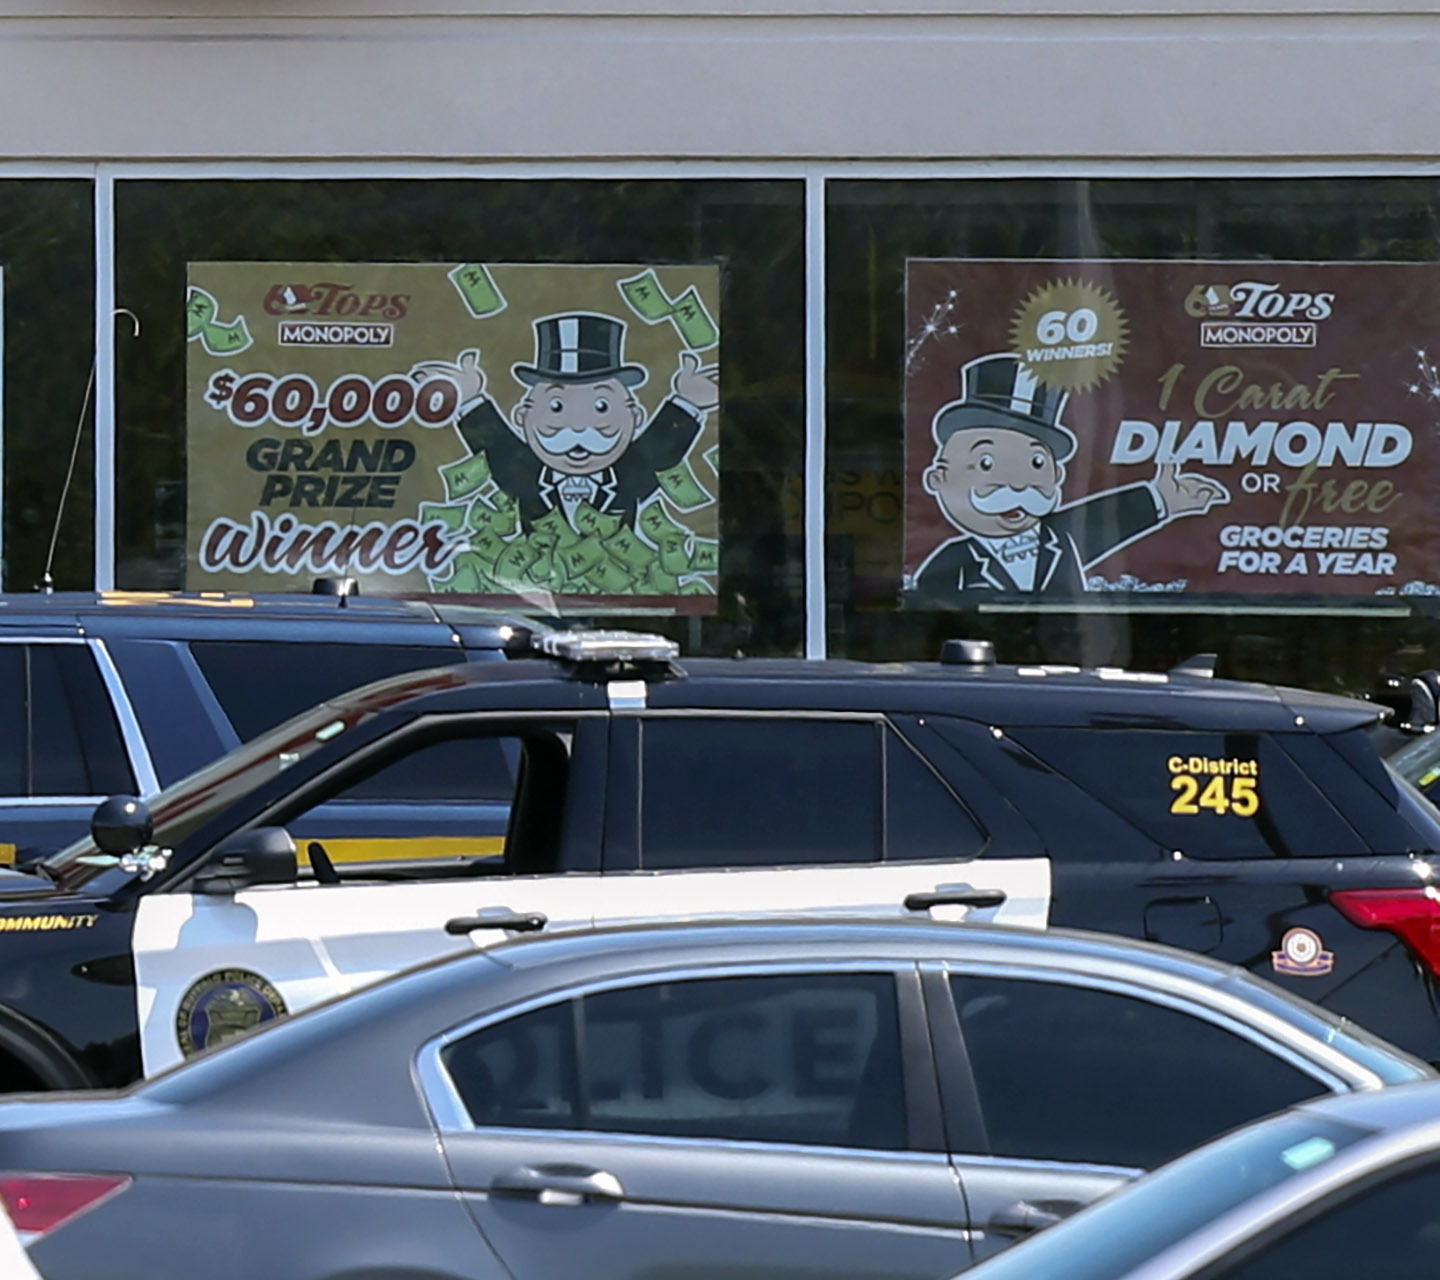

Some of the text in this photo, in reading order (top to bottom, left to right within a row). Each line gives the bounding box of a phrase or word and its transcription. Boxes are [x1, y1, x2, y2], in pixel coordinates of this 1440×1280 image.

[310, 282, 411, 320] TOPS
[1230, 281, 1335, 320] TOPS
[283, 325, 389, 343] MONOPOLY
[1036, 308, 1099, 345] 60
[1205, 326, 1312, 343] MONOPOLY
[1026, 343, 1113, 363] WINNERS!
[208, 374, 458, 430] $60,000
[1158, 364, 1360, 420] 1 Carat
[246, 439, 416, 473] GRAND
[1110, 421, 1413, 468] DIAMOND
[259, 475, 402, 509] PRIZE
[1242, 463, 1403, 530] OR free
[1219, 526, 1390, 550] GROCERIES
[1217, 552, 1398, 576] FOR A YEAR
[1168, 757, 1258, 776] C-District
[1170, 775, 1259, 817] 245
[466, 1009, 860, 1102] OLICE
